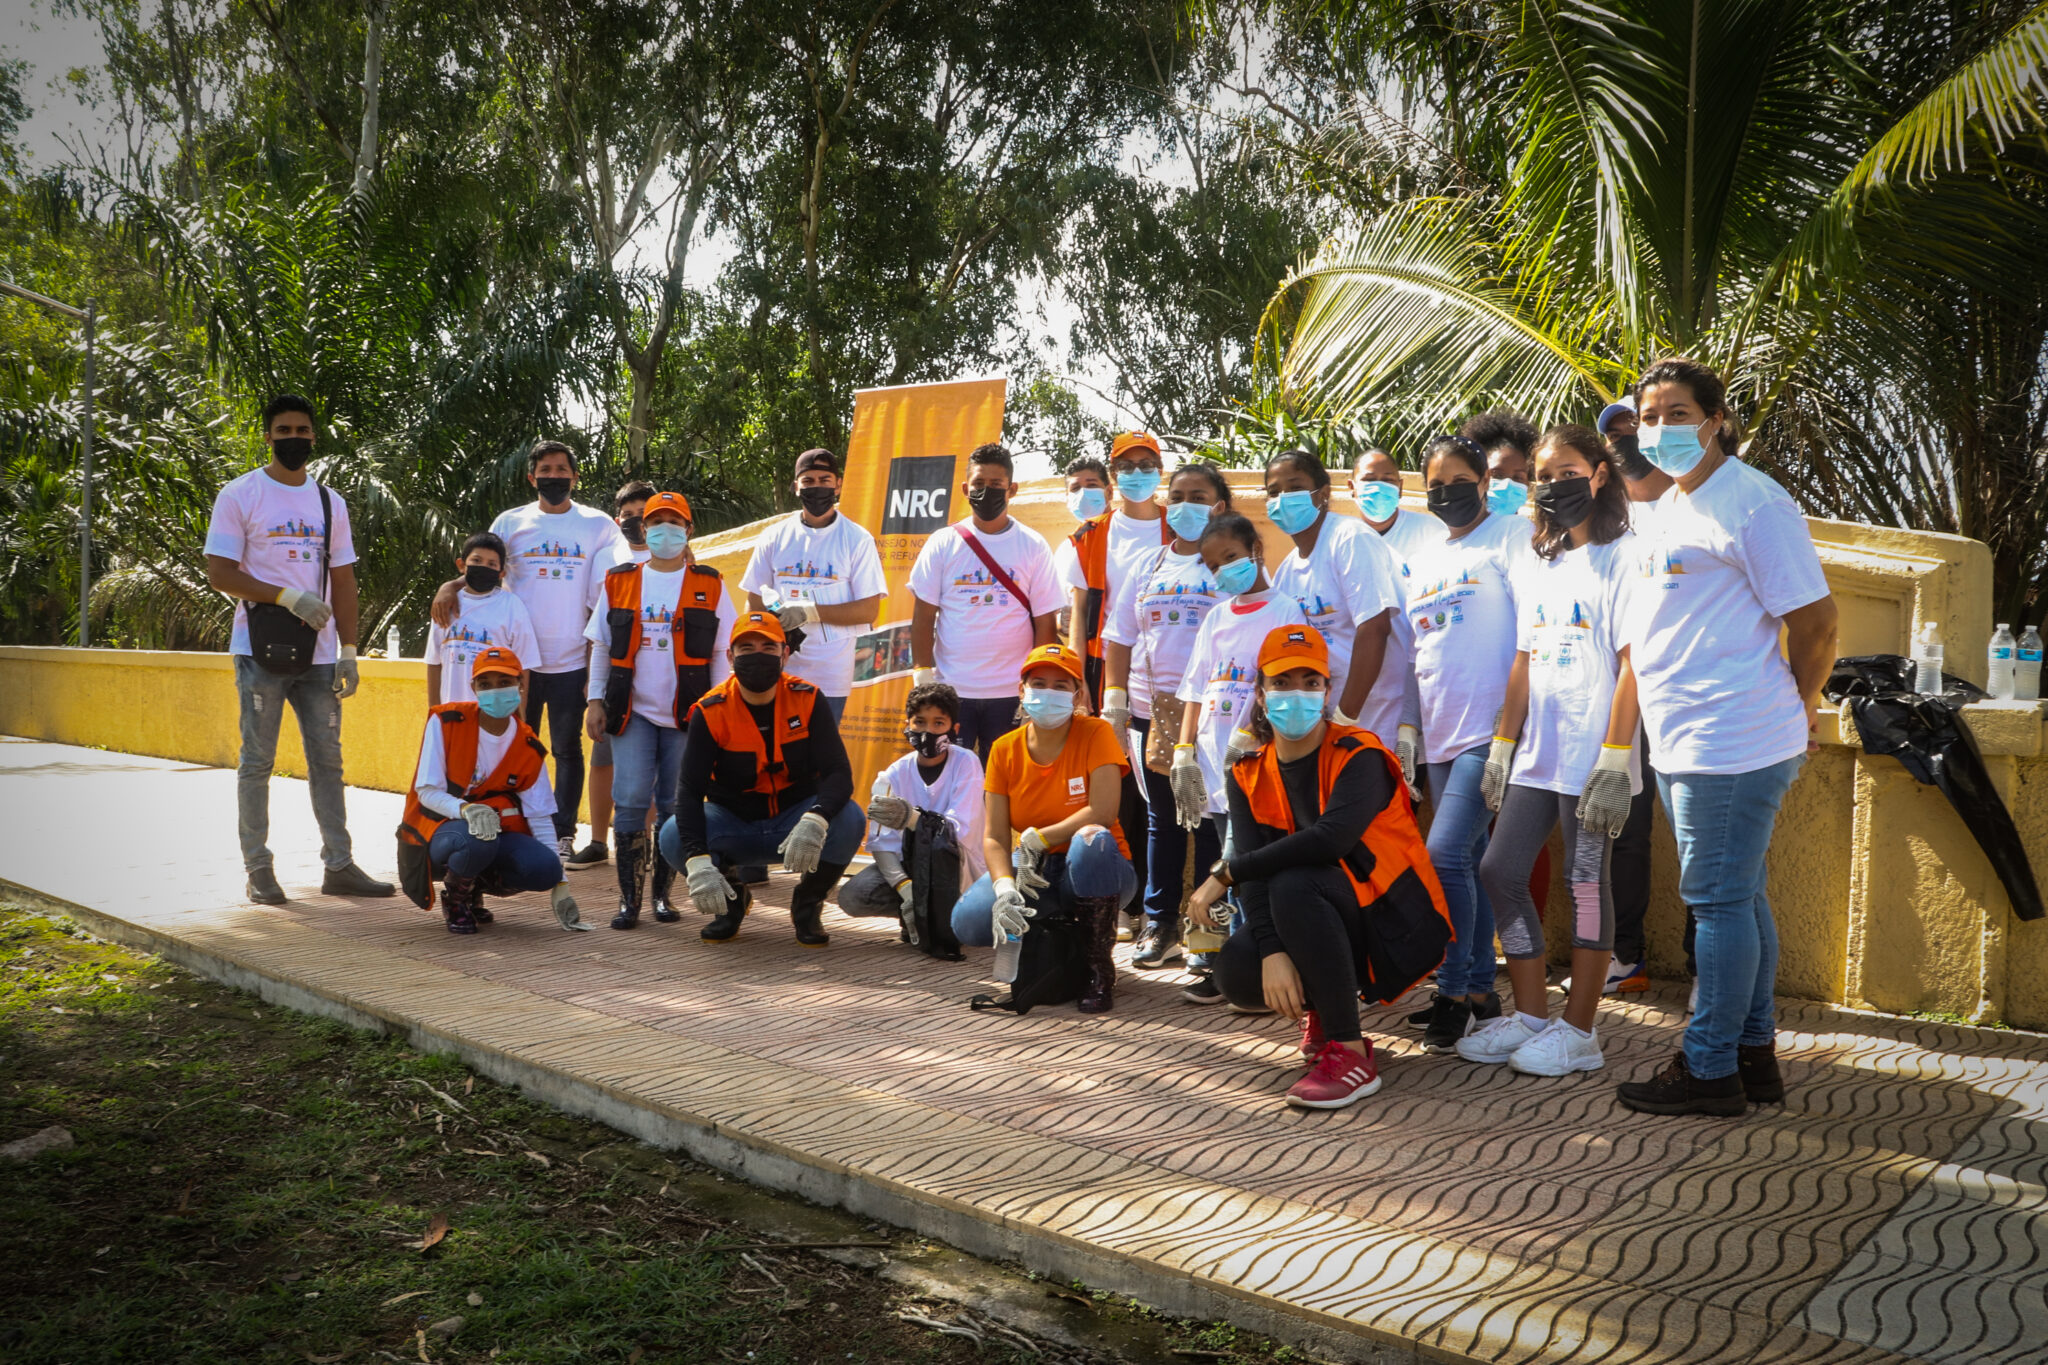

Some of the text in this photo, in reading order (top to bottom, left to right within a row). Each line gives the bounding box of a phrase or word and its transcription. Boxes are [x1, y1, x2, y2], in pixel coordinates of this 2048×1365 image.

[889, 488, 946, 518] NRC
[876, 538, 908, 549] NSEJO
[890, 551, 919, 561] REFU
[1070, 783, 1084, 791] NRC
